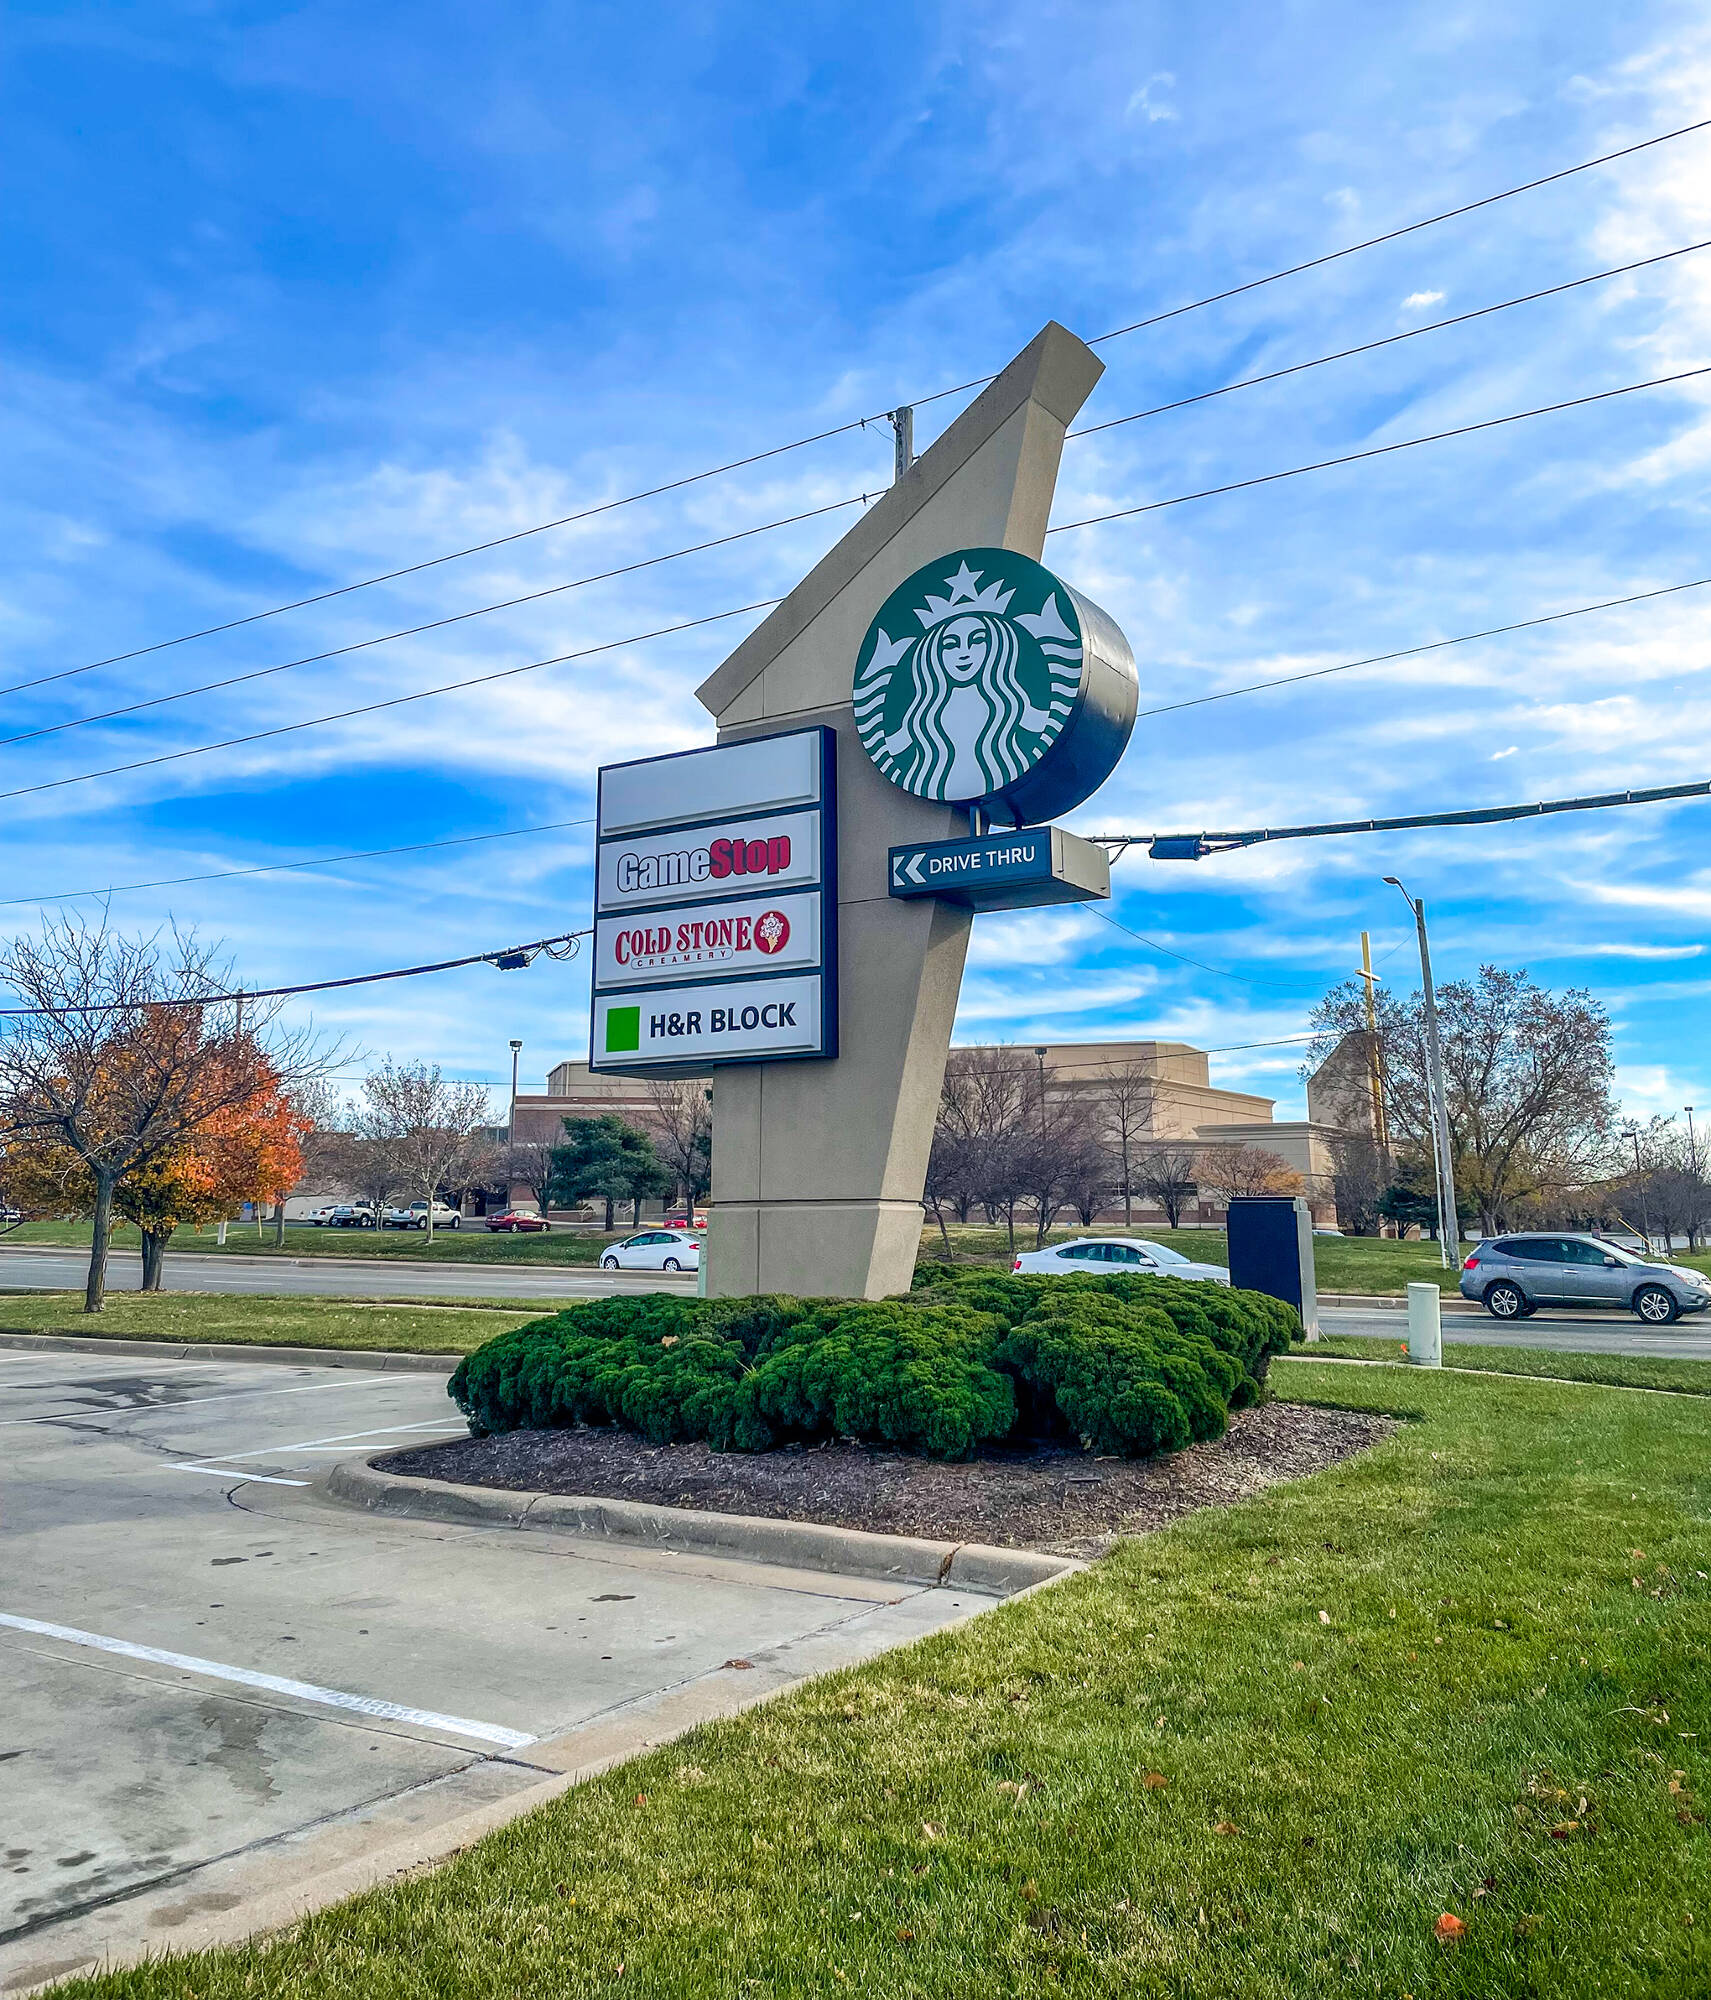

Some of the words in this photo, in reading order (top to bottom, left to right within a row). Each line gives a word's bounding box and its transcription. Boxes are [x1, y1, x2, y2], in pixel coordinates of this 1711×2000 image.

[617, 835, 791, 892] GameStop
[929, 853, 981, 874] DRIVE
[986, 846, 1034, 867] THRU
[615, 927, 672, 966] COLD
[676, 916, 752, 952] STONE
[637, 950, 727, 967] CREAMERY
[650, 1012, 702, 1038] H&R
[710, 1002, 797, 1033] BLOCK
